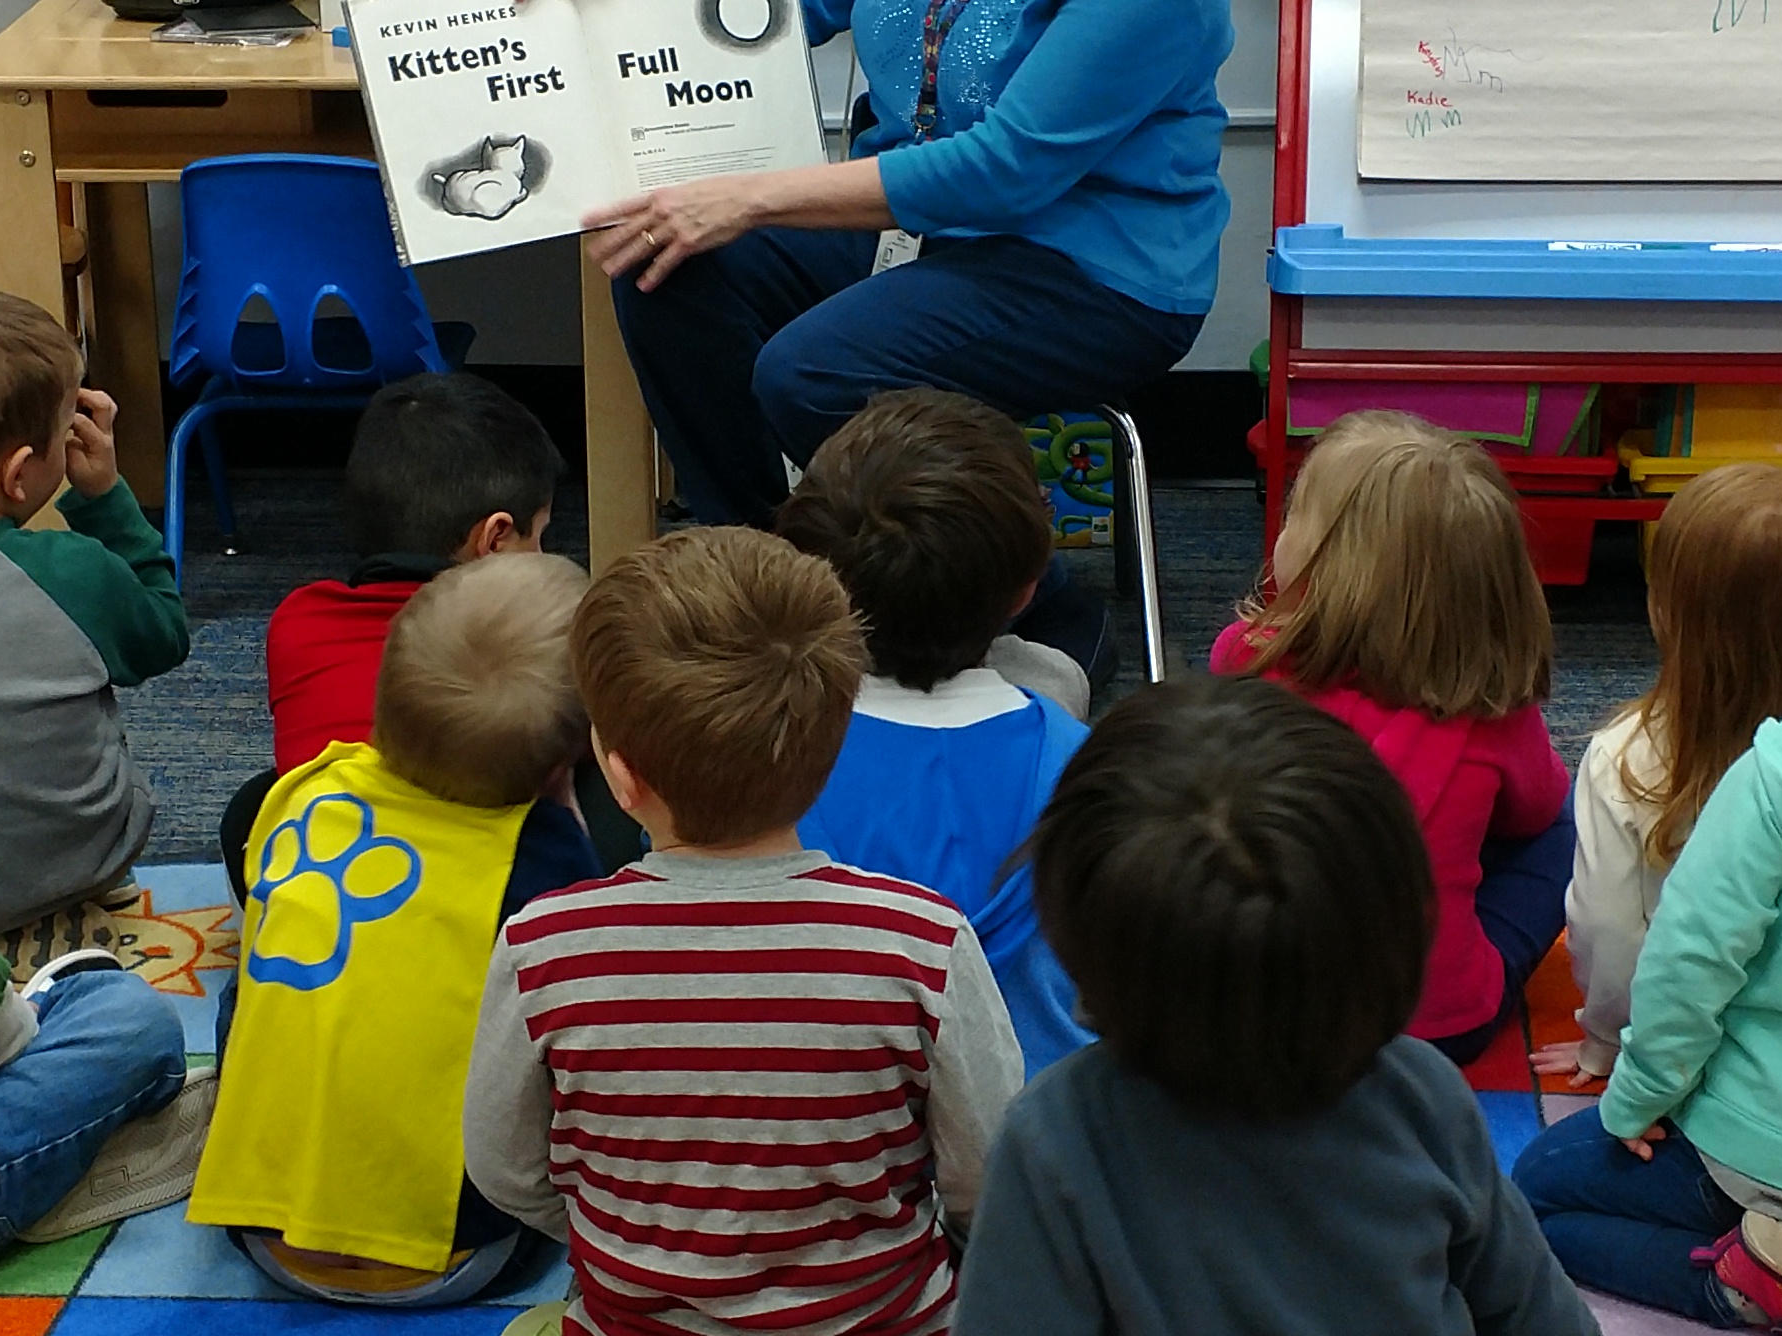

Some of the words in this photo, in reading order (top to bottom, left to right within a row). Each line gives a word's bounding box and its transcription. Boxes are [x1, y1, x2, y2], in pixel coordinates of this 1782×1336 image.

[380, 17, 439, 39] KEVIN
[447, 5, 518, 28] HENKES
[387, 36, 528, 82] Kitten's
[617, 47, 679, 79] Full
[487, 65, 567, 102] First
[666, 76, 754, 107] Moon
